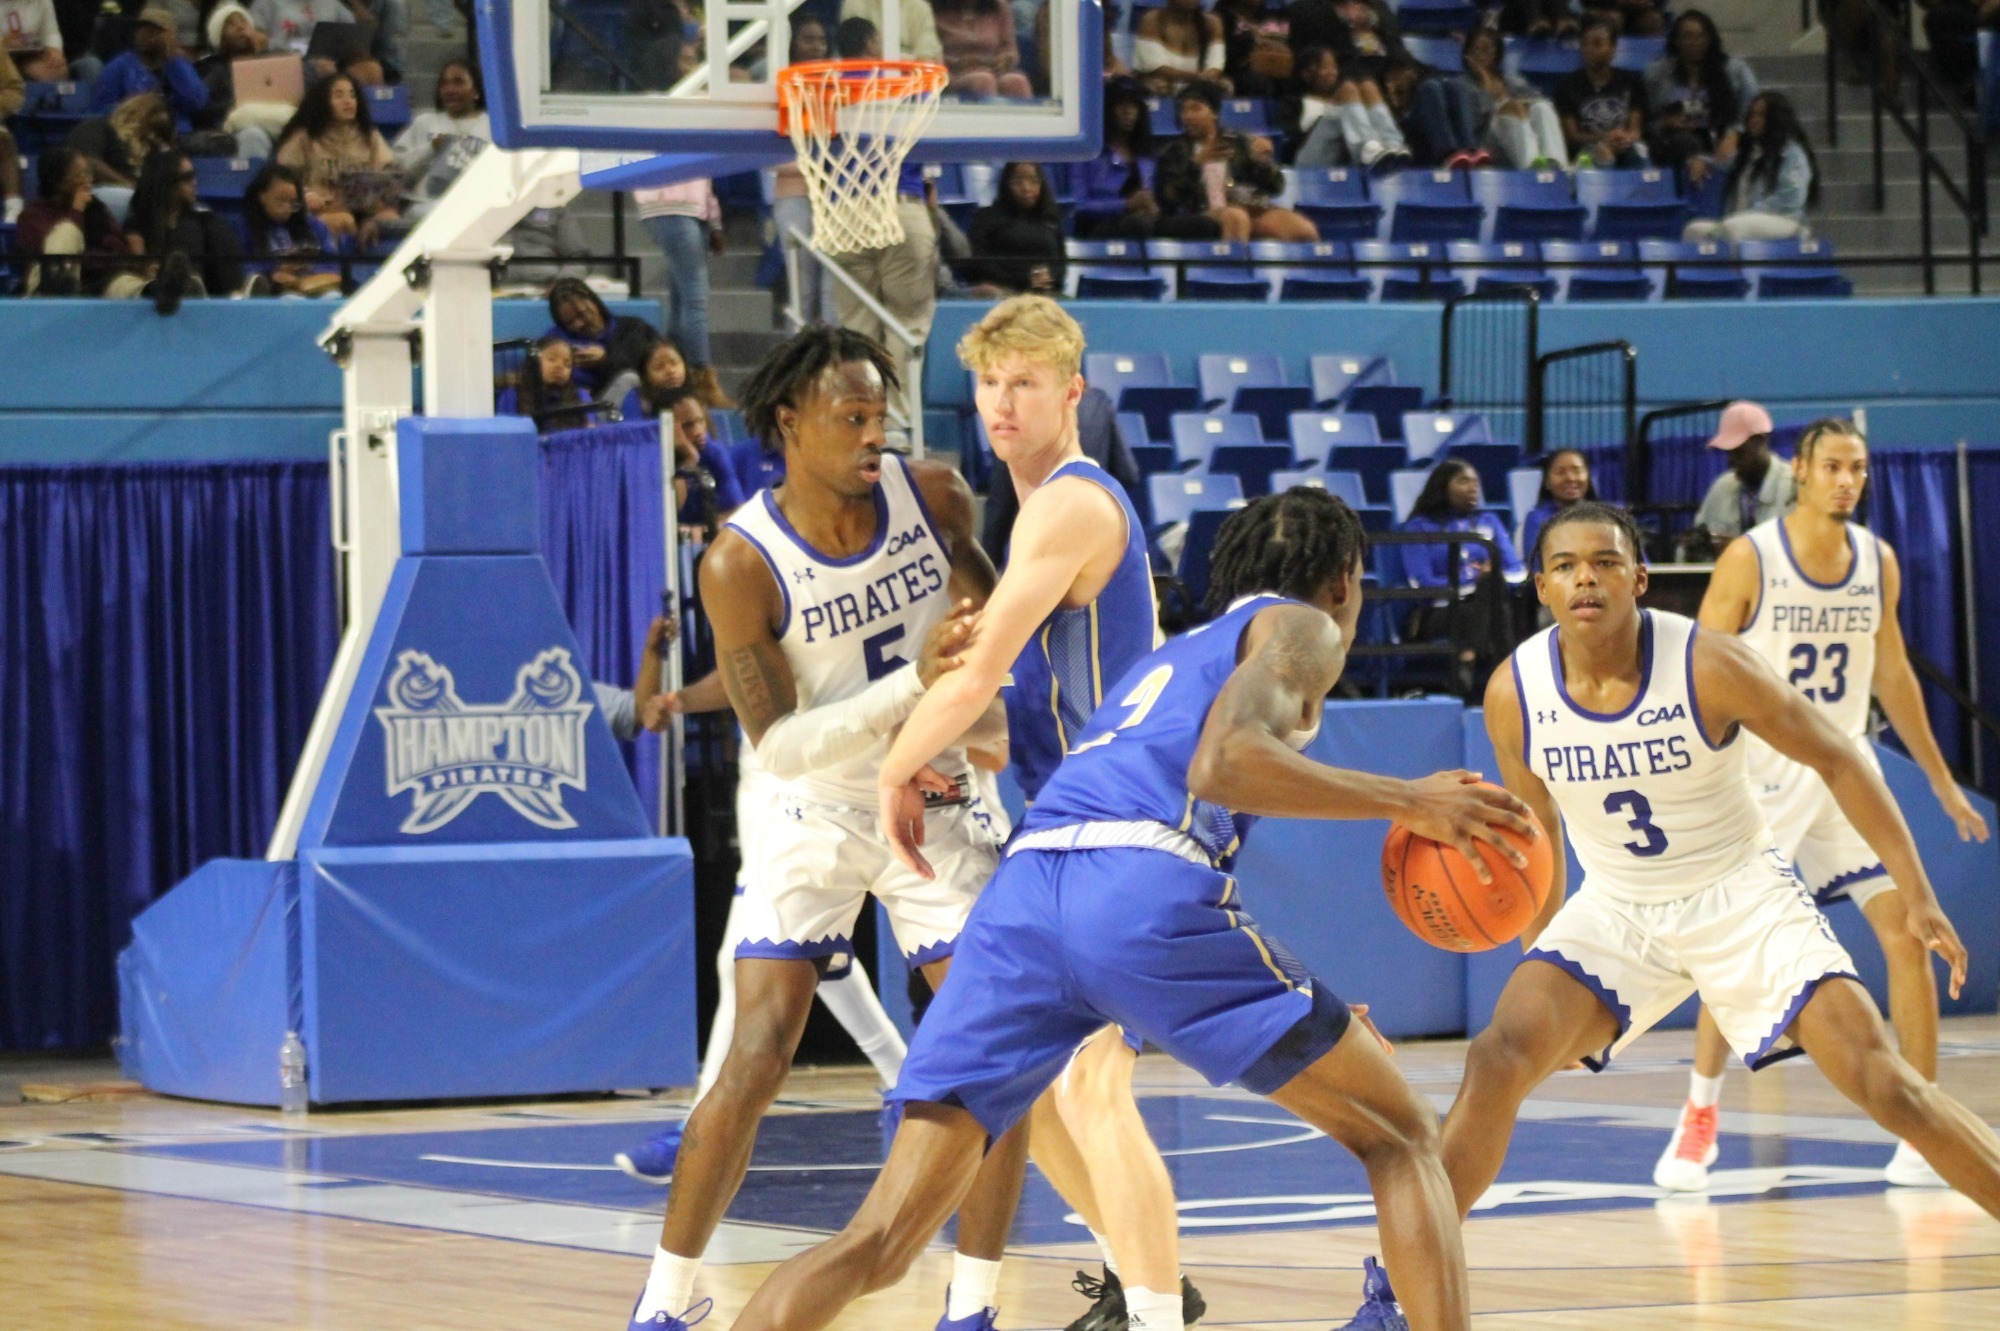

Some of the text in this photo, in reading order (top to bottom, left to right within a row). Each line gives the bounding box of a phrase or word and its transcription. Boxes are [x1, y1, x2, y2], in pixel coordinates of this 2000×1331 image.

[888, 524, 927, 556] CAA
[802, 553, 942, 643] PIRATES
[1772, 605, 1872, 633] PIRATES
[1789, 643, 1849, 704] 23
[1637, 703, 1686, 727] CAA
[394, 713, 579, 784] HAMPTON
[1543, 735, 1692, 782] PIRATES
[430, 766, 544, 790] PIRATES
[1603, 789, 1669, 857] 3
